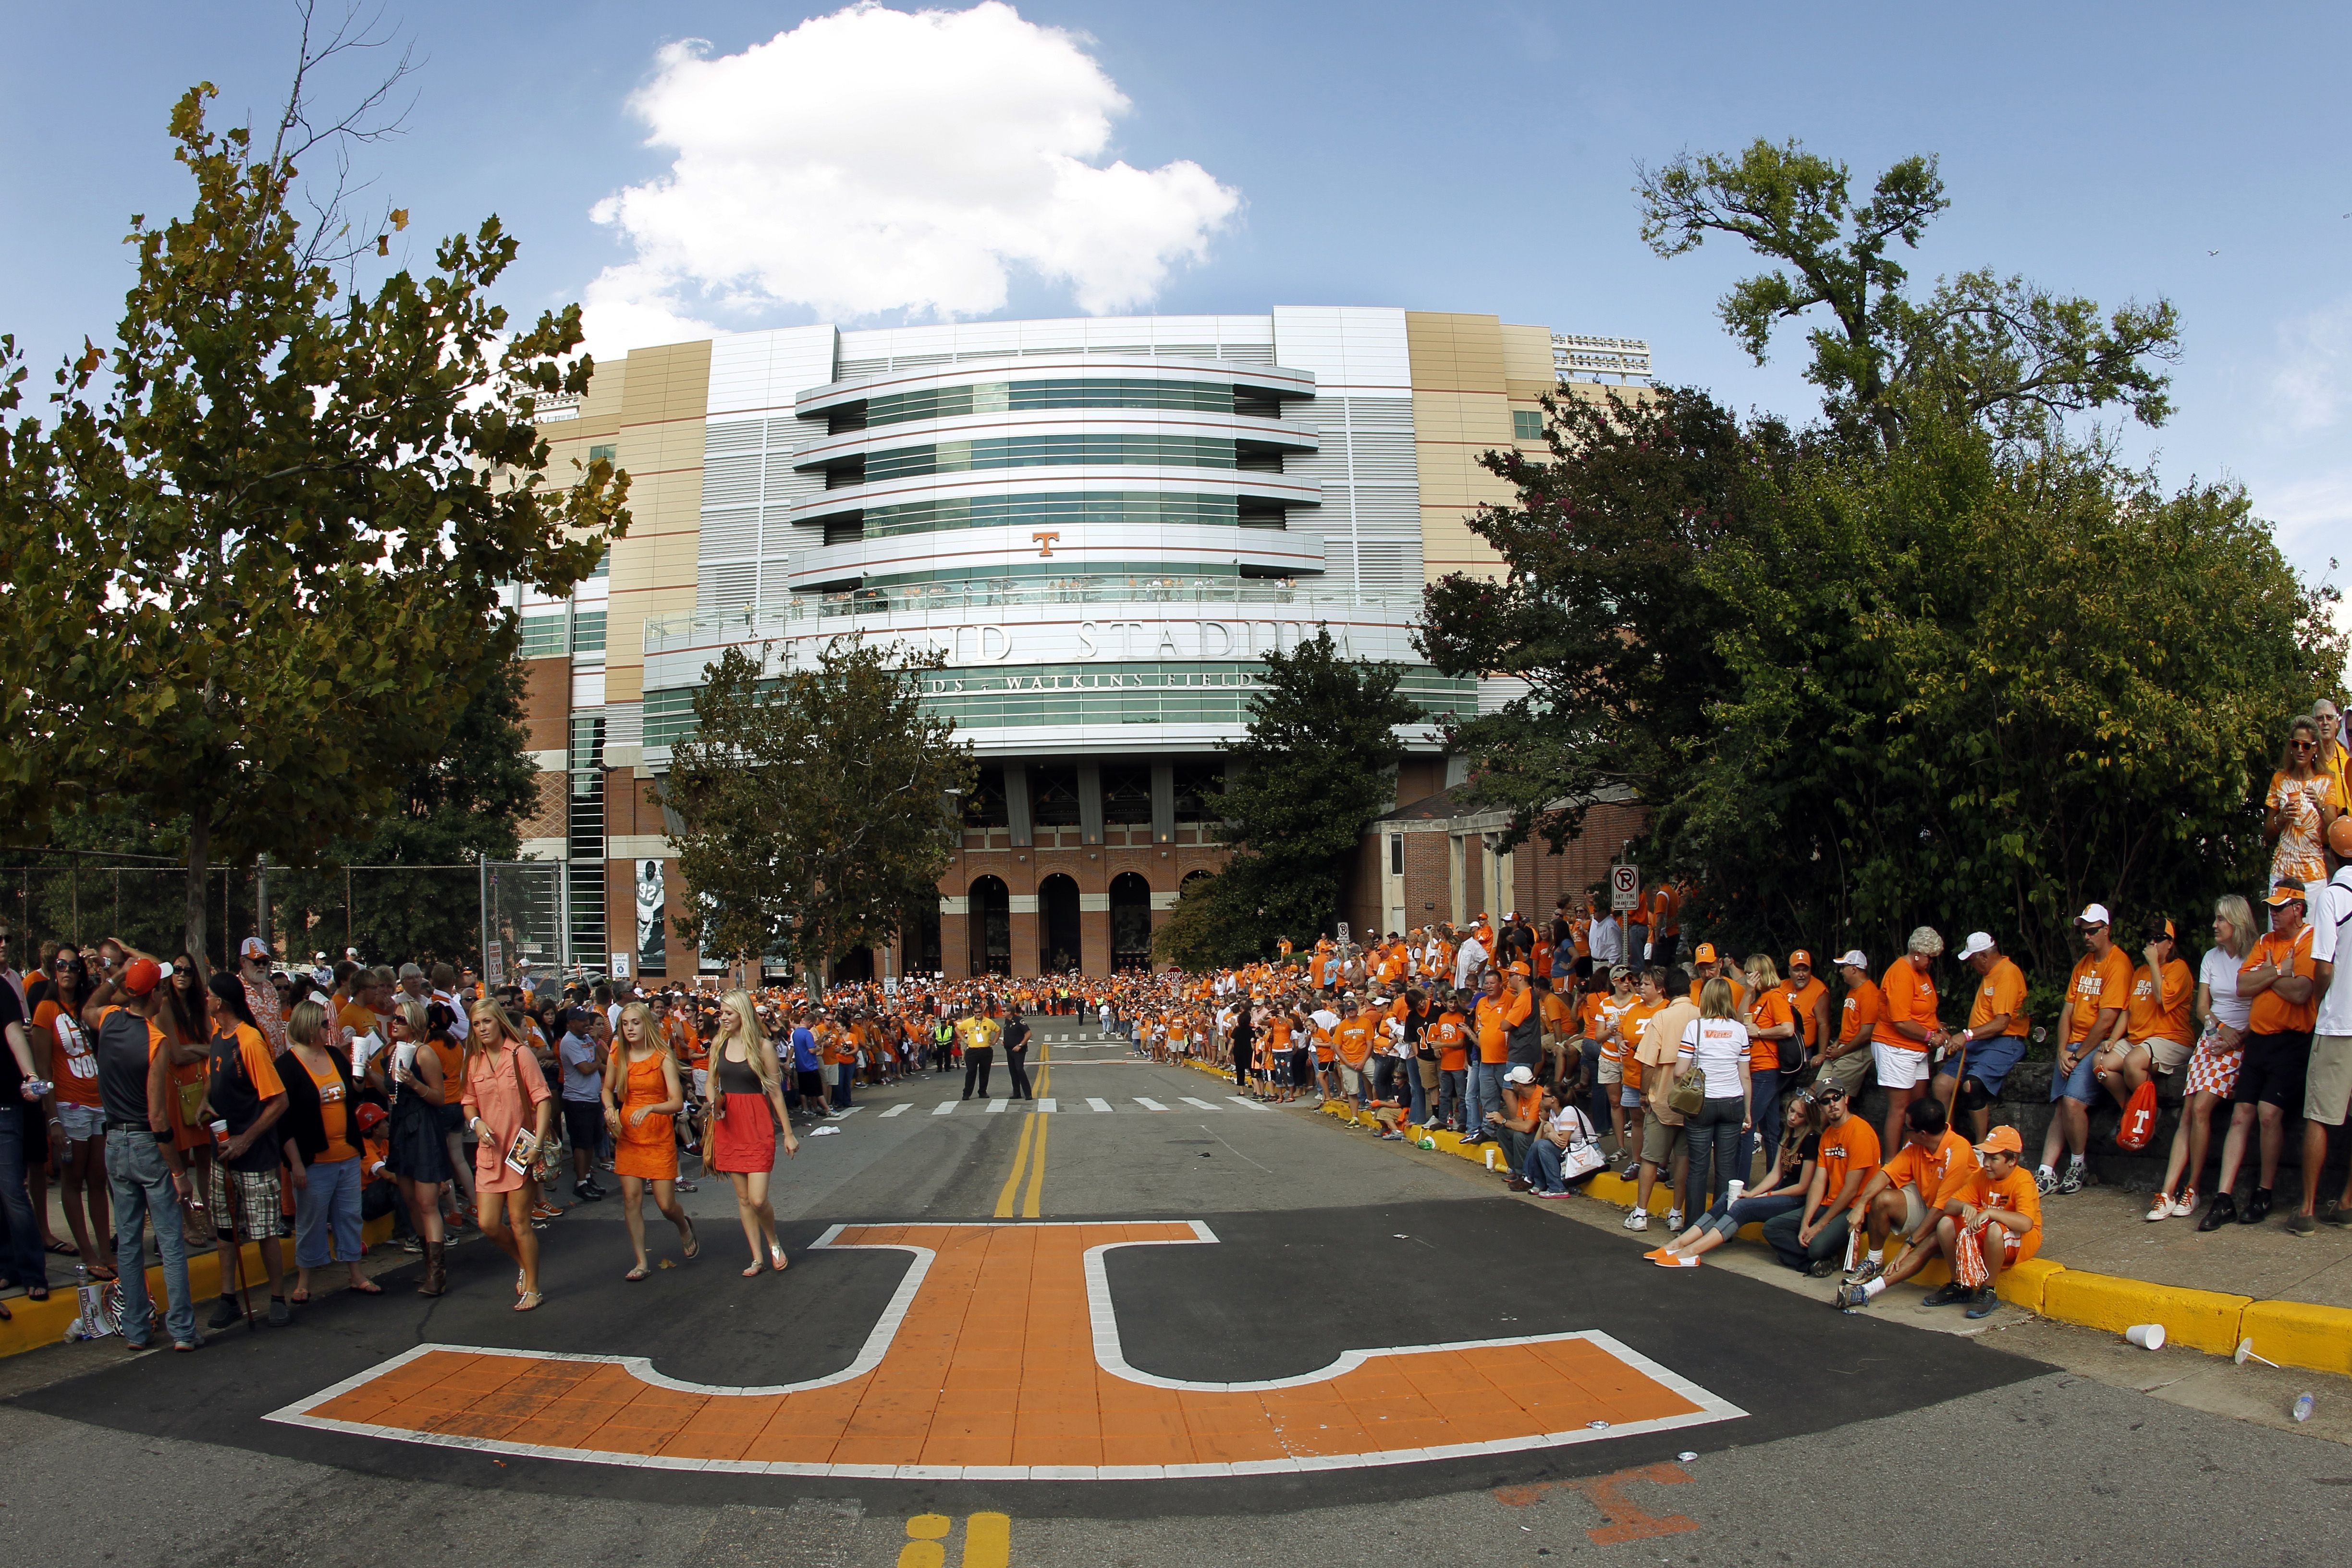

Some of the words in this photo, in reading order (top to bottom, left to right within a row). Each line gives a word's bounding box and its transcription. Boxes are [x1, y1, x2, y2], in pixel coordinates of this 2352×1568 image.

[1033, 531, 1059, 556] T
[737, 625, 1012, 675] NEYAND
[1006, 674, 1143, 690] WATKINS
[1166, 673, 1252, 687] FIELD
[638, 882, 656, 901] 92
[1699, 947, 1707, 955] T
[1635, 1018, 1652, 1034] T
[328, 1086, 341, 1100] T
[2132, 1109, 2149, 1134] T
[1986, 1133, 1997, 1141] T
[1937, 1166, 1944, 1179] T
[1988, 1191, 2000, 1205] T
